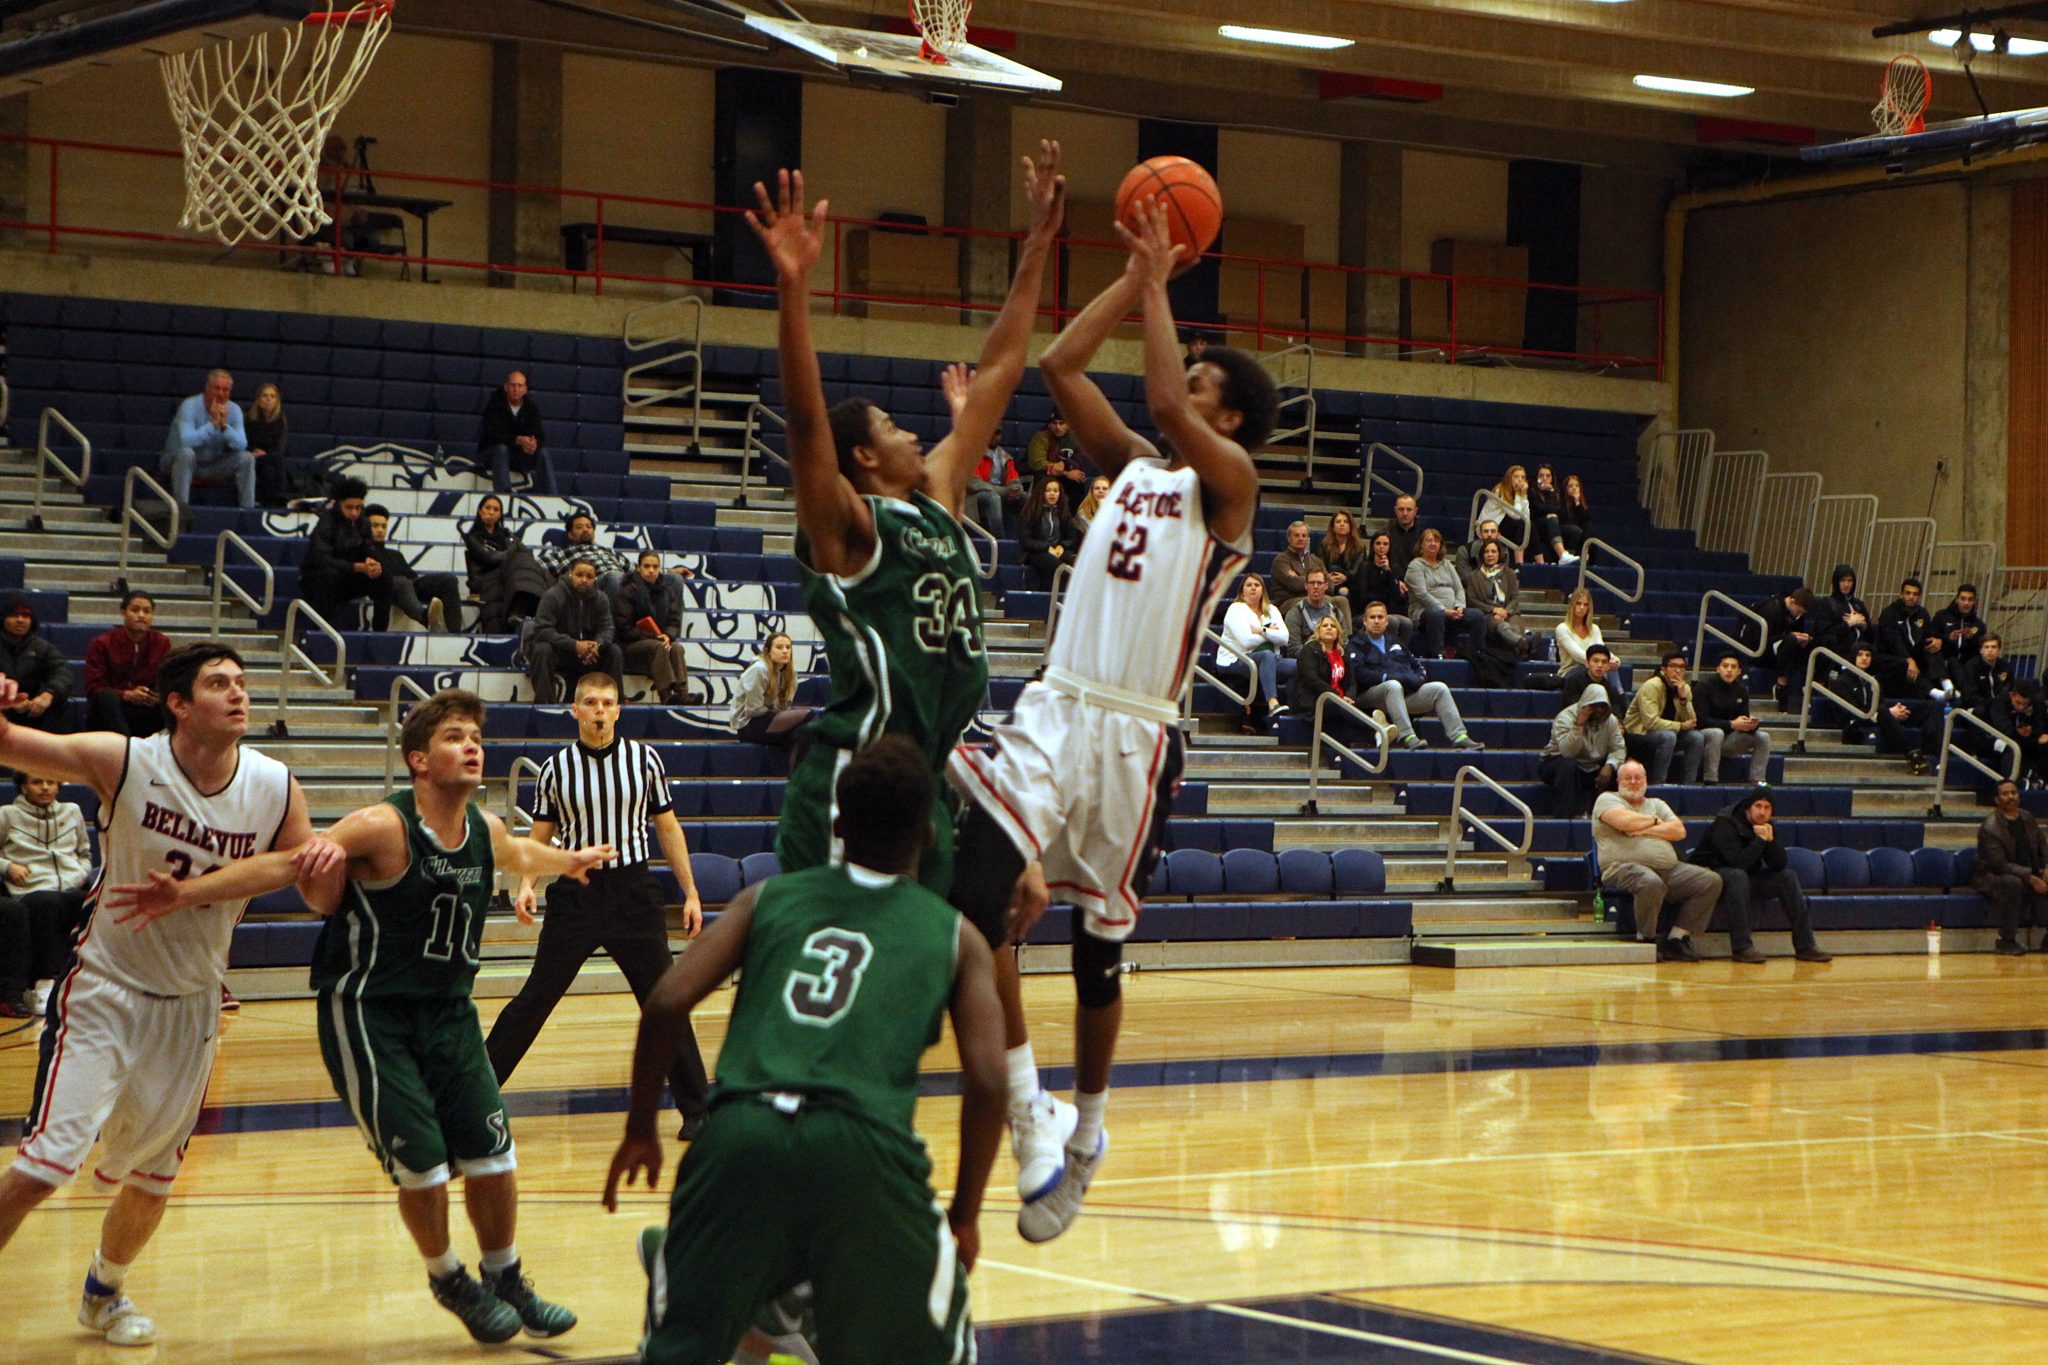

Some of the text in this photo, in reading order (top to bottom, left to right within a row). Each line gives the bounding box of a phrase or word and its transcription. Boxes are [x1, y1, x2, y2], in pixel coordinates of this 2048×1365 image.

[912, 571, 983, 657] 34
[141, 800, 257, 860] BELLEVUE
[782, 927, 874, 1029] 3
